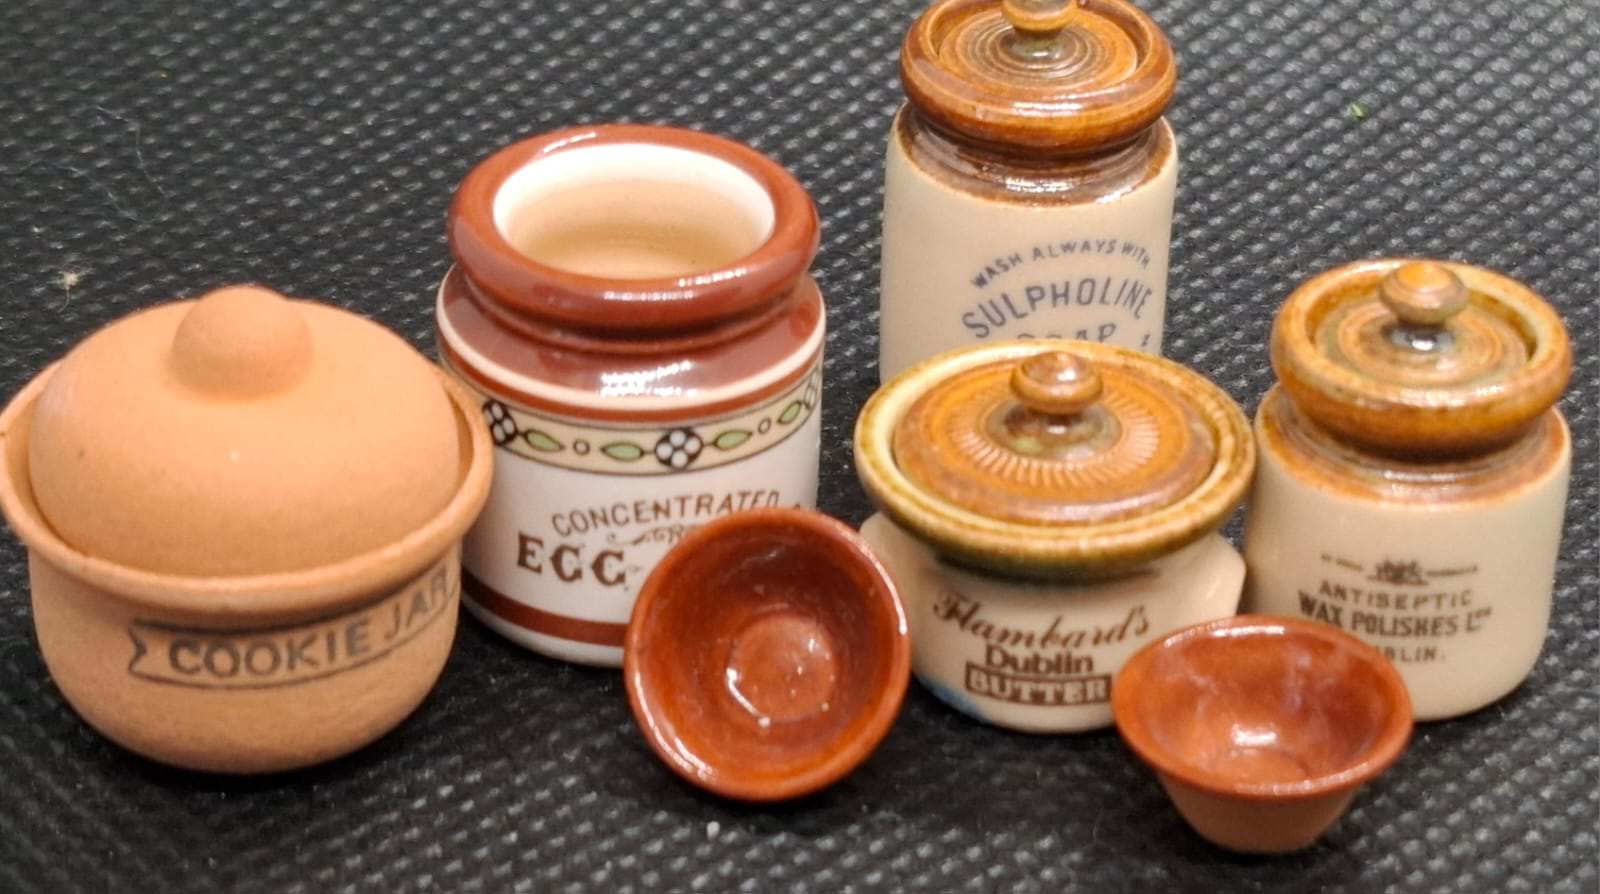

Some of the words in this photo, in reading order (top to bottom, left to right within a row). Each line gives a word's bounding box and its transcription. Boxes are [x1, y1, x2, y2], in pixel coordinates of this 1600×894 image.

[970, 252, 1023, 289] WASH
[1031, 239, 1117, 260] ALWAYS
[1120, 242, 1150, 269] WITH
[961, 276, 1152, 339] SULPHOLINE
[516, 531, 626, 587] EGG
[932, 588, 1150, 649] Flambard's
[1297, 590, 1343, 629] WAX
[1351, 610, 1458, 638] POLISHES
[1319, 580, 1472, 610] ANTISEPTIC
[169, 618, 370, 678] COOKIE
[384, 565, 448, 641] JAR
[968, 664, 1110, 704] BUTTER
[985, 643, 1094, 675] Dublin
